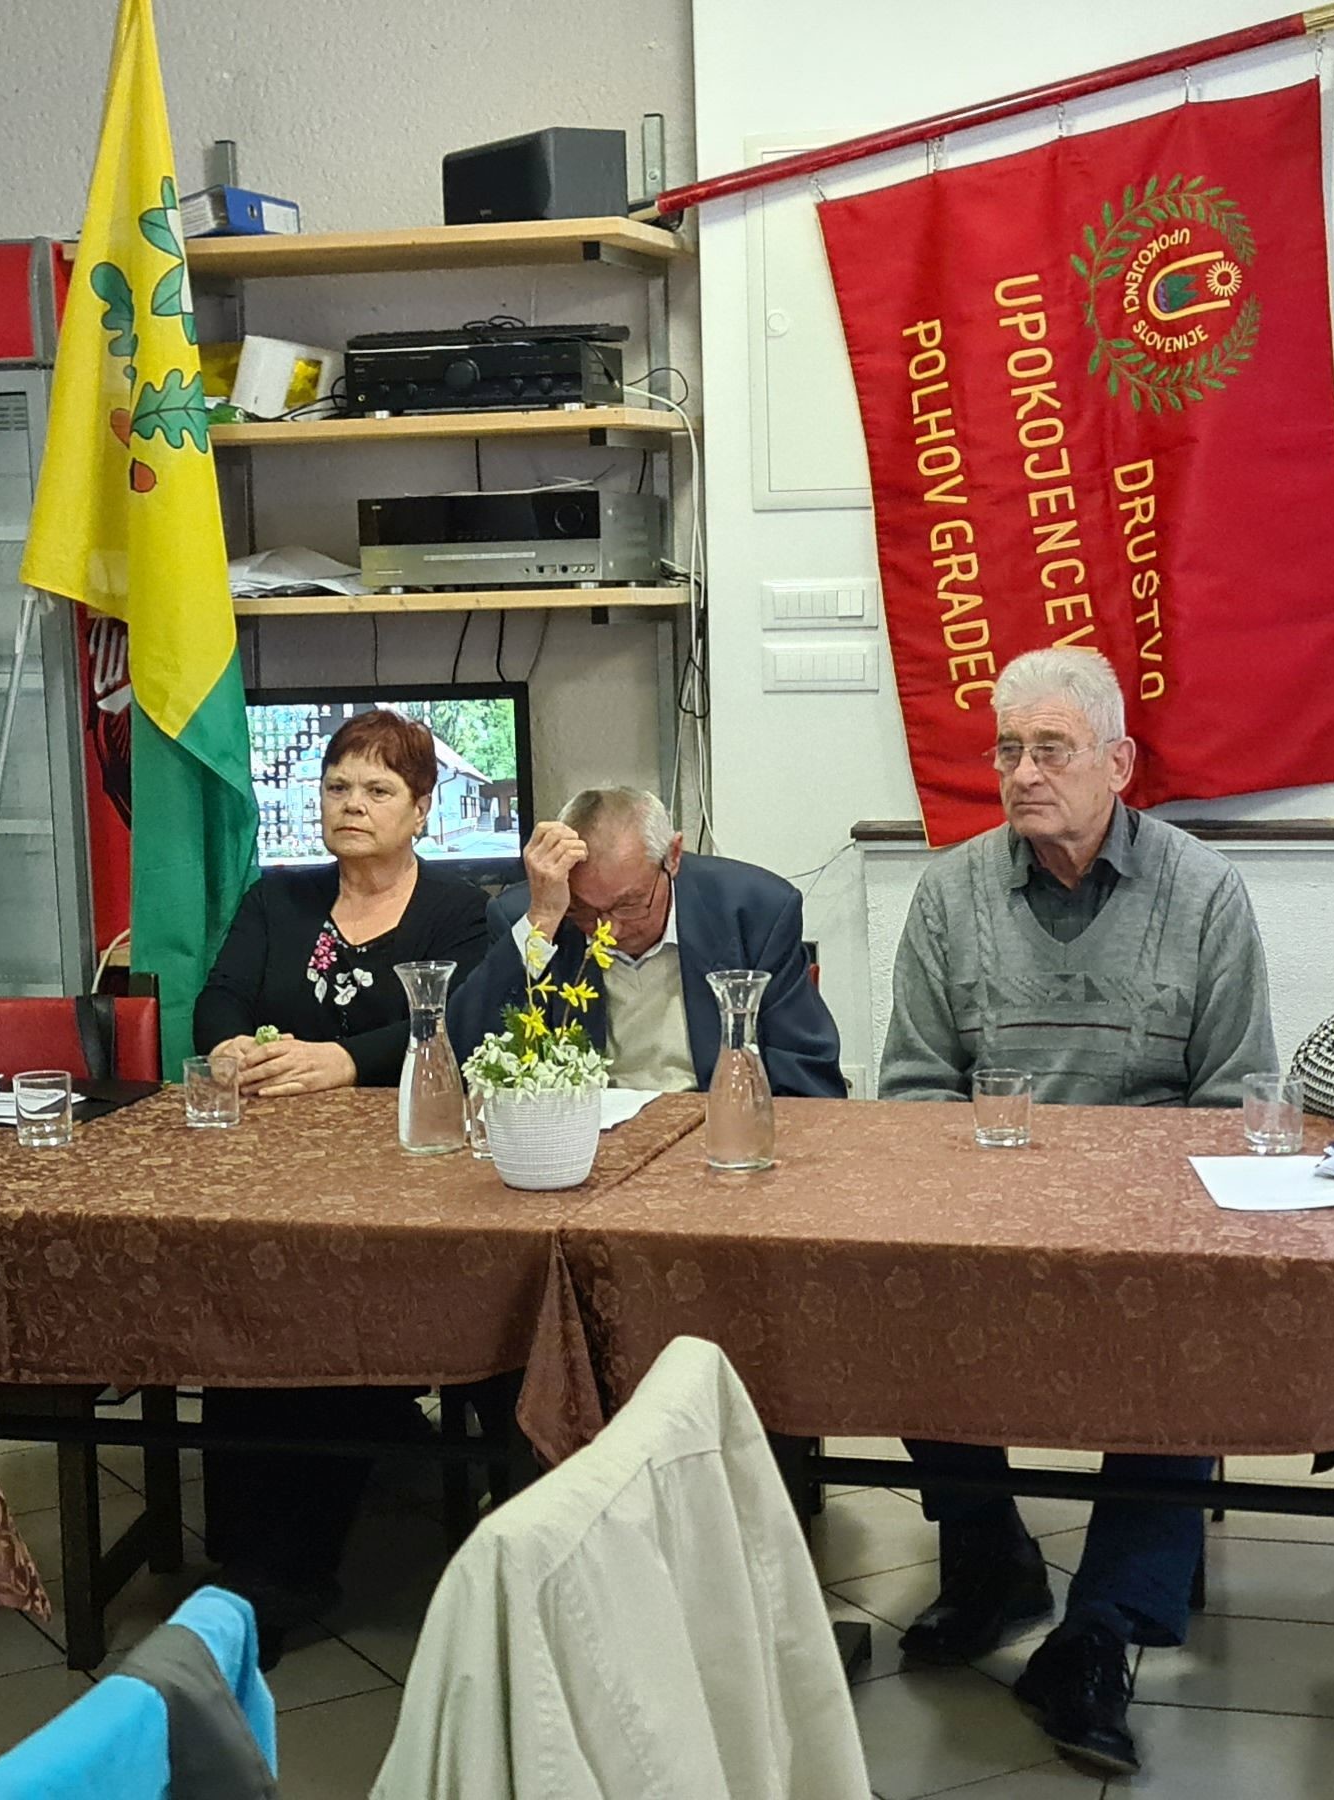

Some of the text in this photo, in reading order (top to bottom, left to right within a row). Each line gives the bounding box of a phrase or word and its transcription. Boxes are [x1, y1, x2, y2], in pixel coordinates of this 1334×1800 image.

[1123, 227, 1209, 353] UPOKOJENCI SLOVENIJE
[902, 319, 996, 710] POLHOV GRADEC
[994, 273, 1098, 655] UPOKOJENCEV
[1114, 459, 1165, 701] DRUŠTVO
